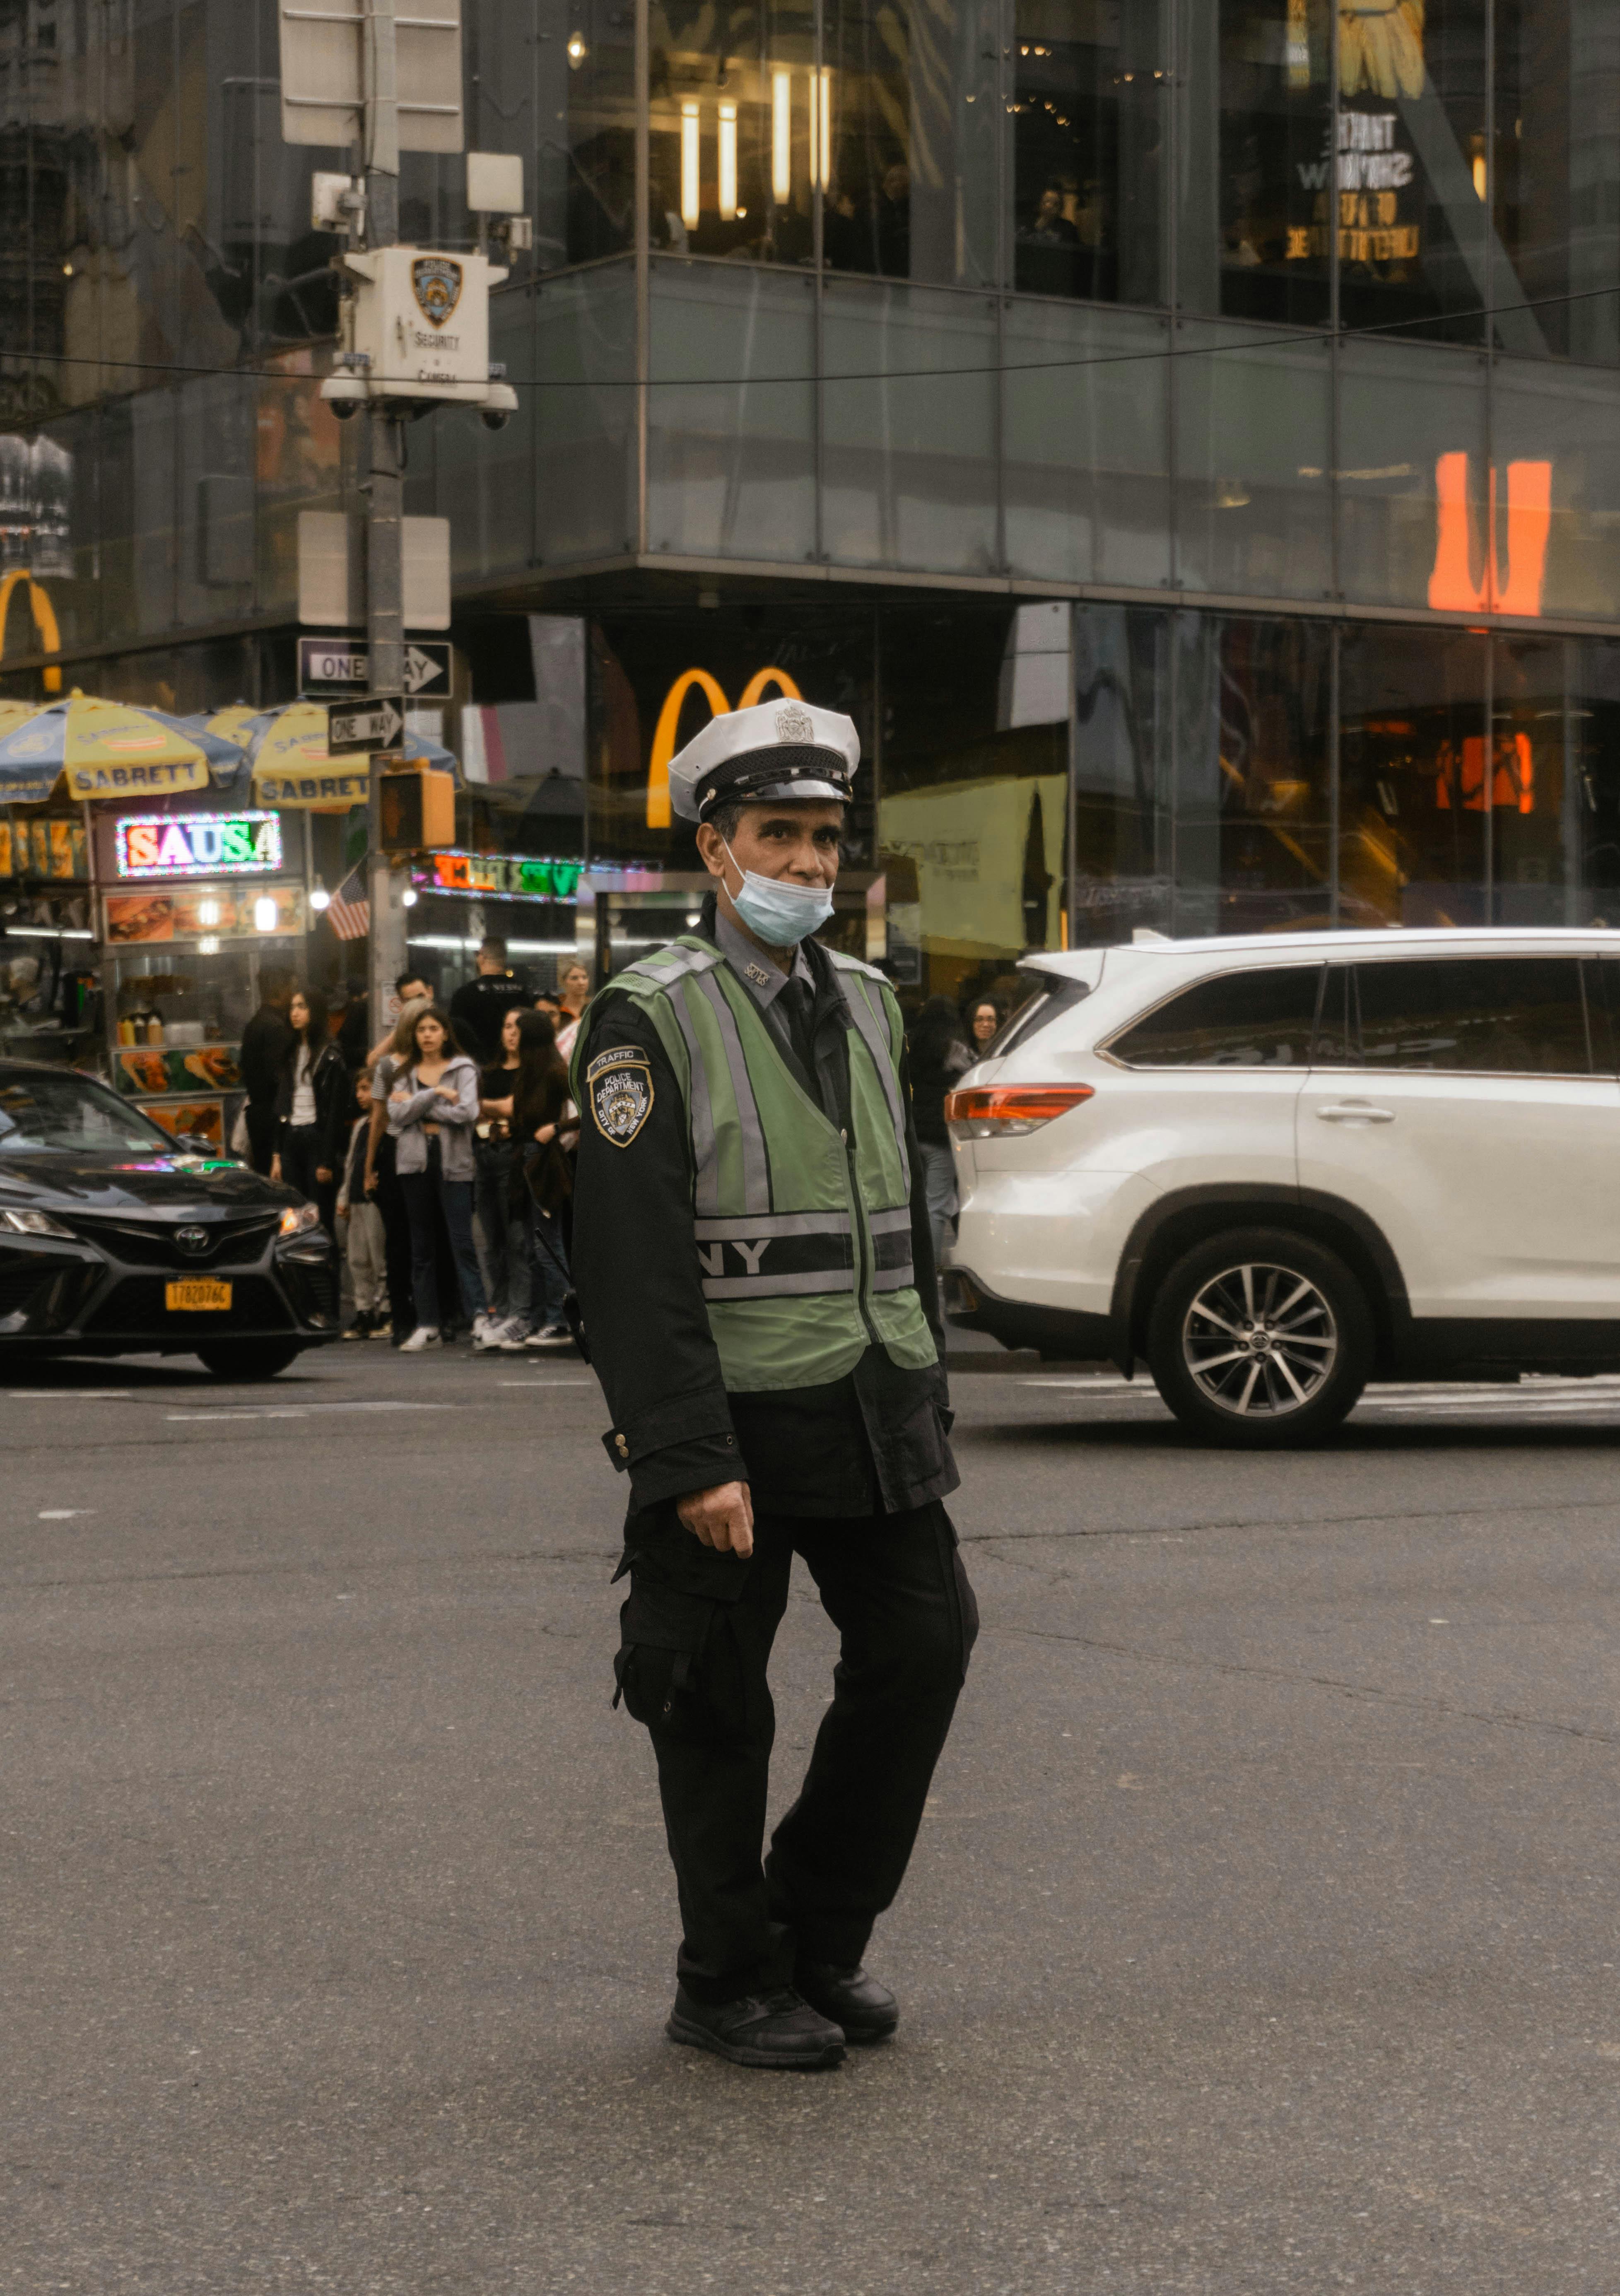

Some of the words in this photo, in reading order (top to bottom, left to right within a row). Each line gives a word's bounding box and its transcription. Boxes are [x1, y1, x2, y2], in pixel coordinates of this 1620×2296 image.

[323, 657, 365, 678] ONE
[403, 661, 427, 680] AY
[333, 718, 357, 739] ONE
[369, 713, 393, 735] WAY
[76, 763, 196, 791] SABRETT
[262, 776, 368, 800] SABRET
[597, 1051, 634, 1067] TRAFFIC
[605, 1073, 632, 1087] POLICE
[597, 1082, 644, 1103] DEPARTMENT
[598, 1110, 610, 1127] CITY
[608, 1127, 616, 1135] OF
[627, 1120, 639, 1135] NEW
[636, 1096, 647, 1117] YORK
